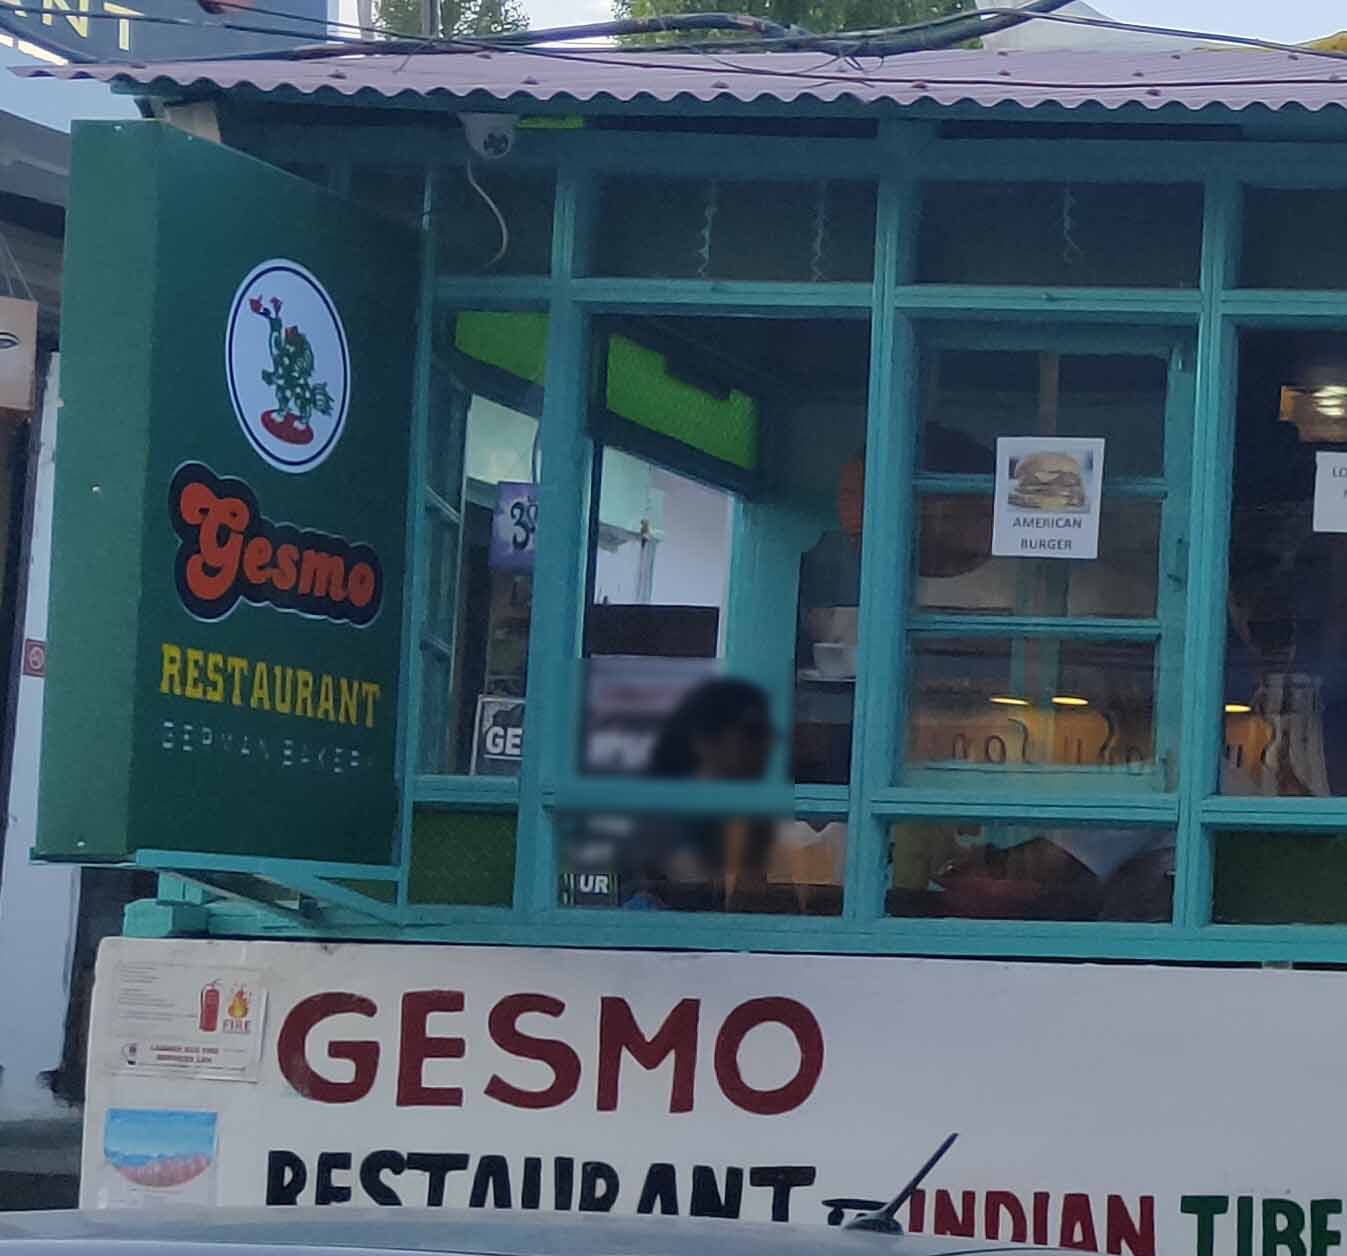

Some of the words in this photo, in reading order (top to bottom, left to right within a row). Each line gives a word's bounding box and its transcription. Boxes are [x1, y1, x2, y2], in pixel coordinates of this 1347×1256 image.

[0, 0, 146, 51] NT
[180, 482, 375, 607] Gesmo
[1012, 517, 1082, 529] AMERICAN
[1020, 538, 1072, 551] BURGER
[160, 643, 380, 728] RESTAURANT
[277, 989, 825, 1116] GESMO
